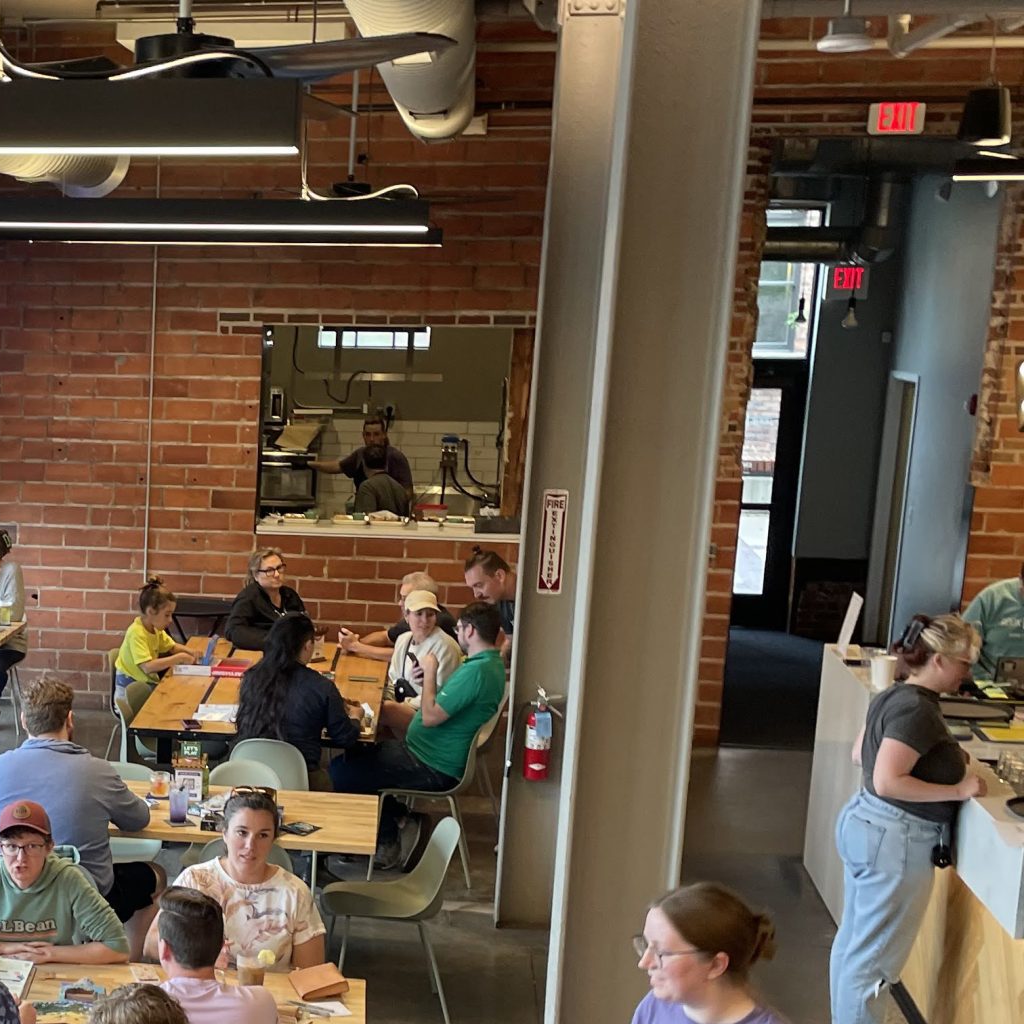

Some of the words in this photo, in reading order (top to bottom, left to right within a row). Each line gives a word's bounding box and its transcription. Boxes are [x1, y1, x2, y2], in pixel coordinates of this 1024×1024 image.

[878, 102, 919, 132] EXIT
[834, 268, 864, 288] EXIT
[546, 500, 564, 508] FIRE
[546, 511, 558, 584] EXTINGUISHER
